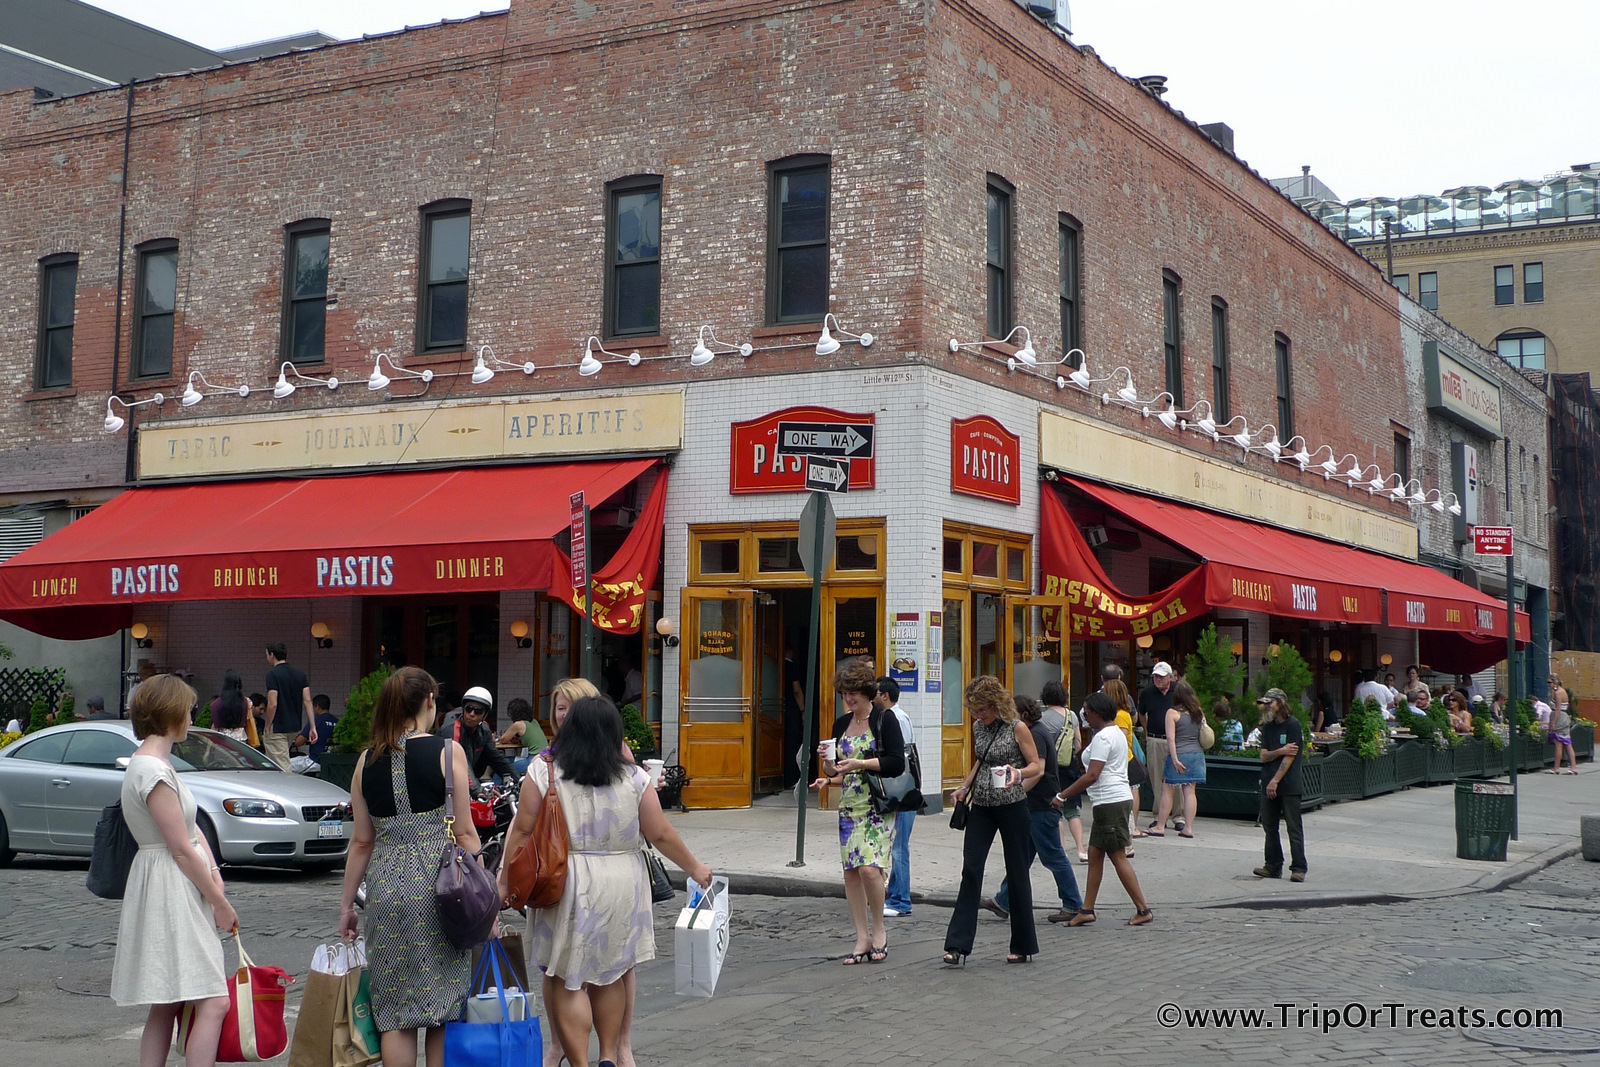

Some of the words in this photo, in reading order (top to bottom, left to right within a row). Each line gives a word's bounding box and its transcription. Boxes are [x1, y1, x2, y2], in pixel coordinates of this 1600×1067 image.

[863, 374, 881, 384] Little
[168, 435, 231, 460] TABAC
[305, 422, 420, 454] JOURNAUX
[508, 408, 644, 439] APERITIFS
[791, 432, 818, 446] ONE
[830, 434, 859, 448] WAY
[811, 465, 825, 481] ONE
[828, 468, 844, 485] WAY
[963, 444, 1010, 486] PASTIS
[1476, 528, 1484, 536] NO
[1485, 529, 1511, 537] STANDING
[1480, 536, 1507, 544] ANYTIME
[32, 577, 77, 597] LUNCH
[111, 563, 180, 595] PASTIS
[214, 566, 278, 587] BRUNCH
[316, 555, 394, 587] PASTIS
[436, 556, 504, 580] DINNER
[1044, 574, 1153, 617] BISTROT
[1232, 577, 1272, 602] BREAKFAST
[1291, 583, 1317, 612] PASTIS
[1130, 597, 1188, 636] BAR
[1406, 600, 1426, 624] PASTIS
[891, 629, 917, 640] BREAD
